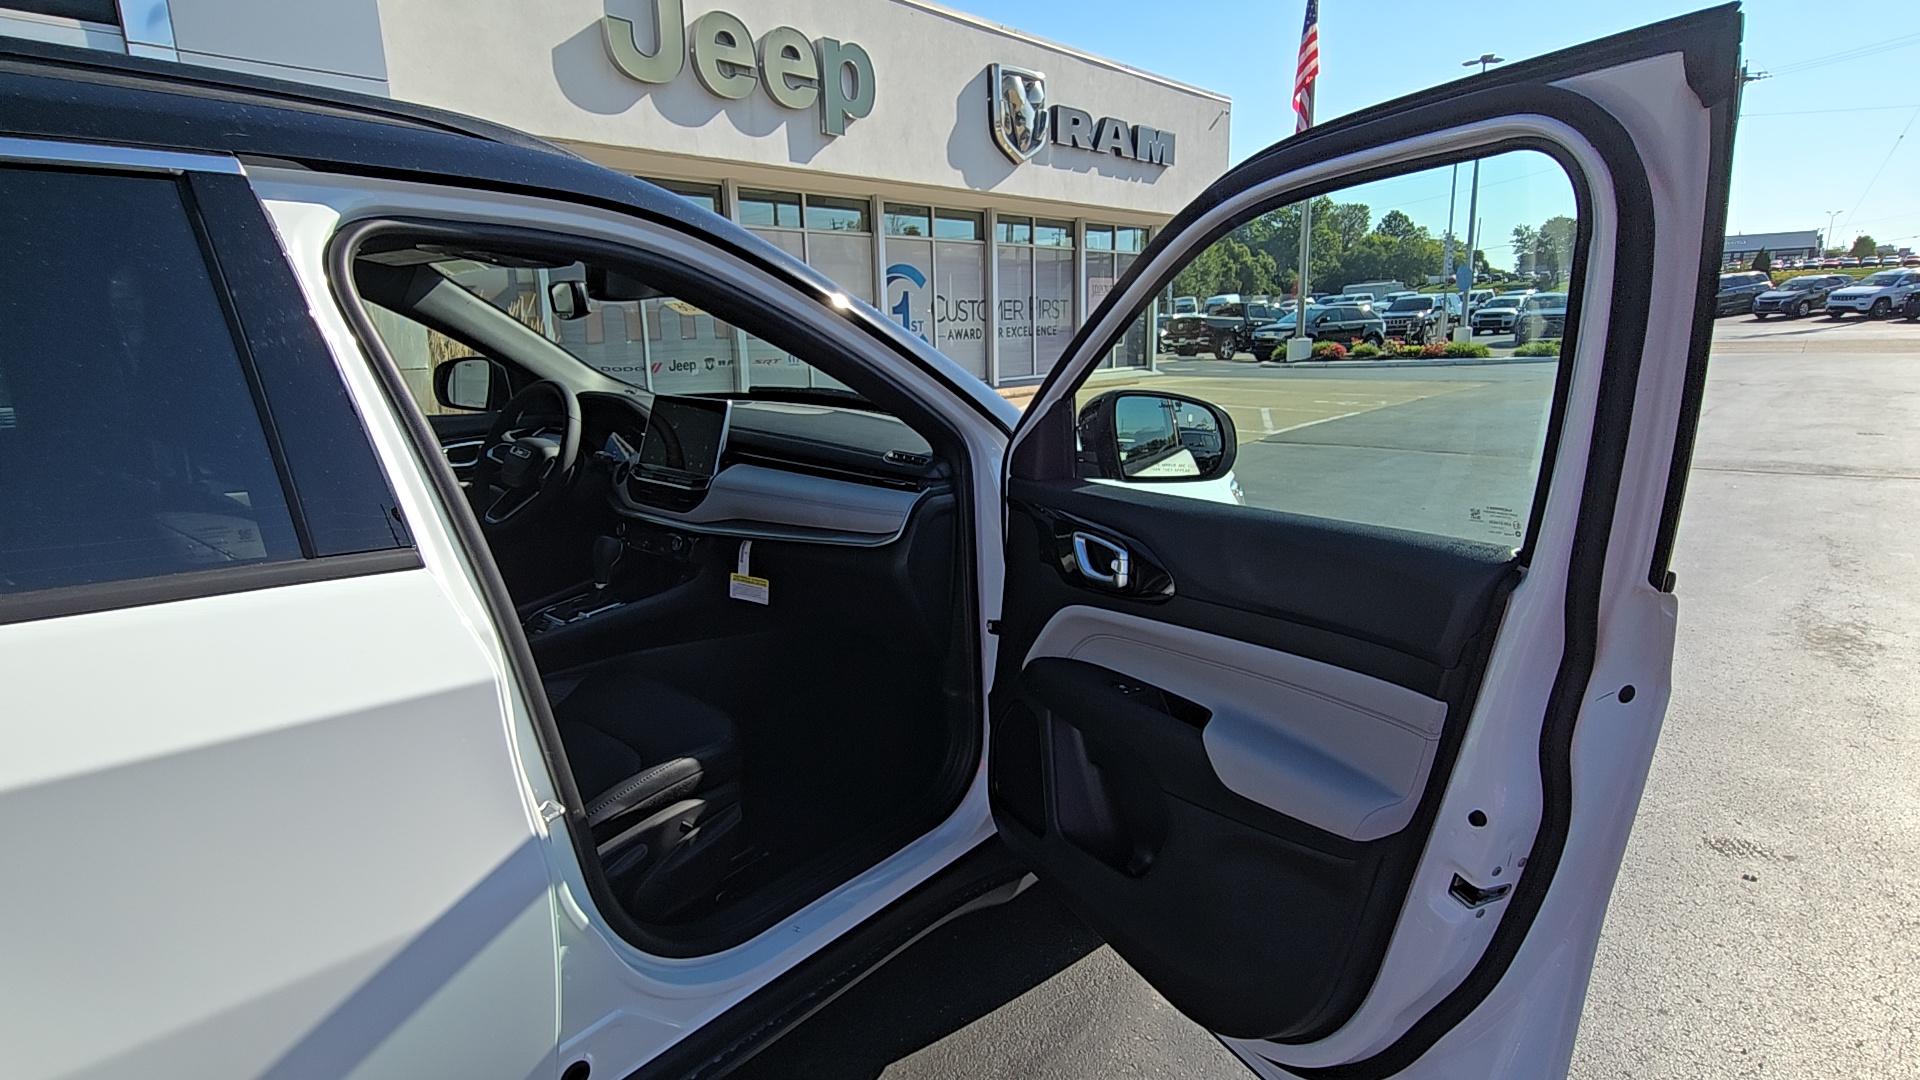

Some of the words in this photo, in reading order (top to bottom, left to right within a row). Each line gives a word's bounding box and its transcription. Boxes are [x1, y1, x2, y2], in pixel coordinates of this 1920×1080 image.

[604, 0, 875, 137] Jeep
[1051, 105, 1177, 167] RAM
[947, 327, 983, 341] AWARD
[1006, 325, 1058, 338] EXCELENCE
[668, 359, 697, 372] Jeep
[752, 357, 782, 366] SRT
